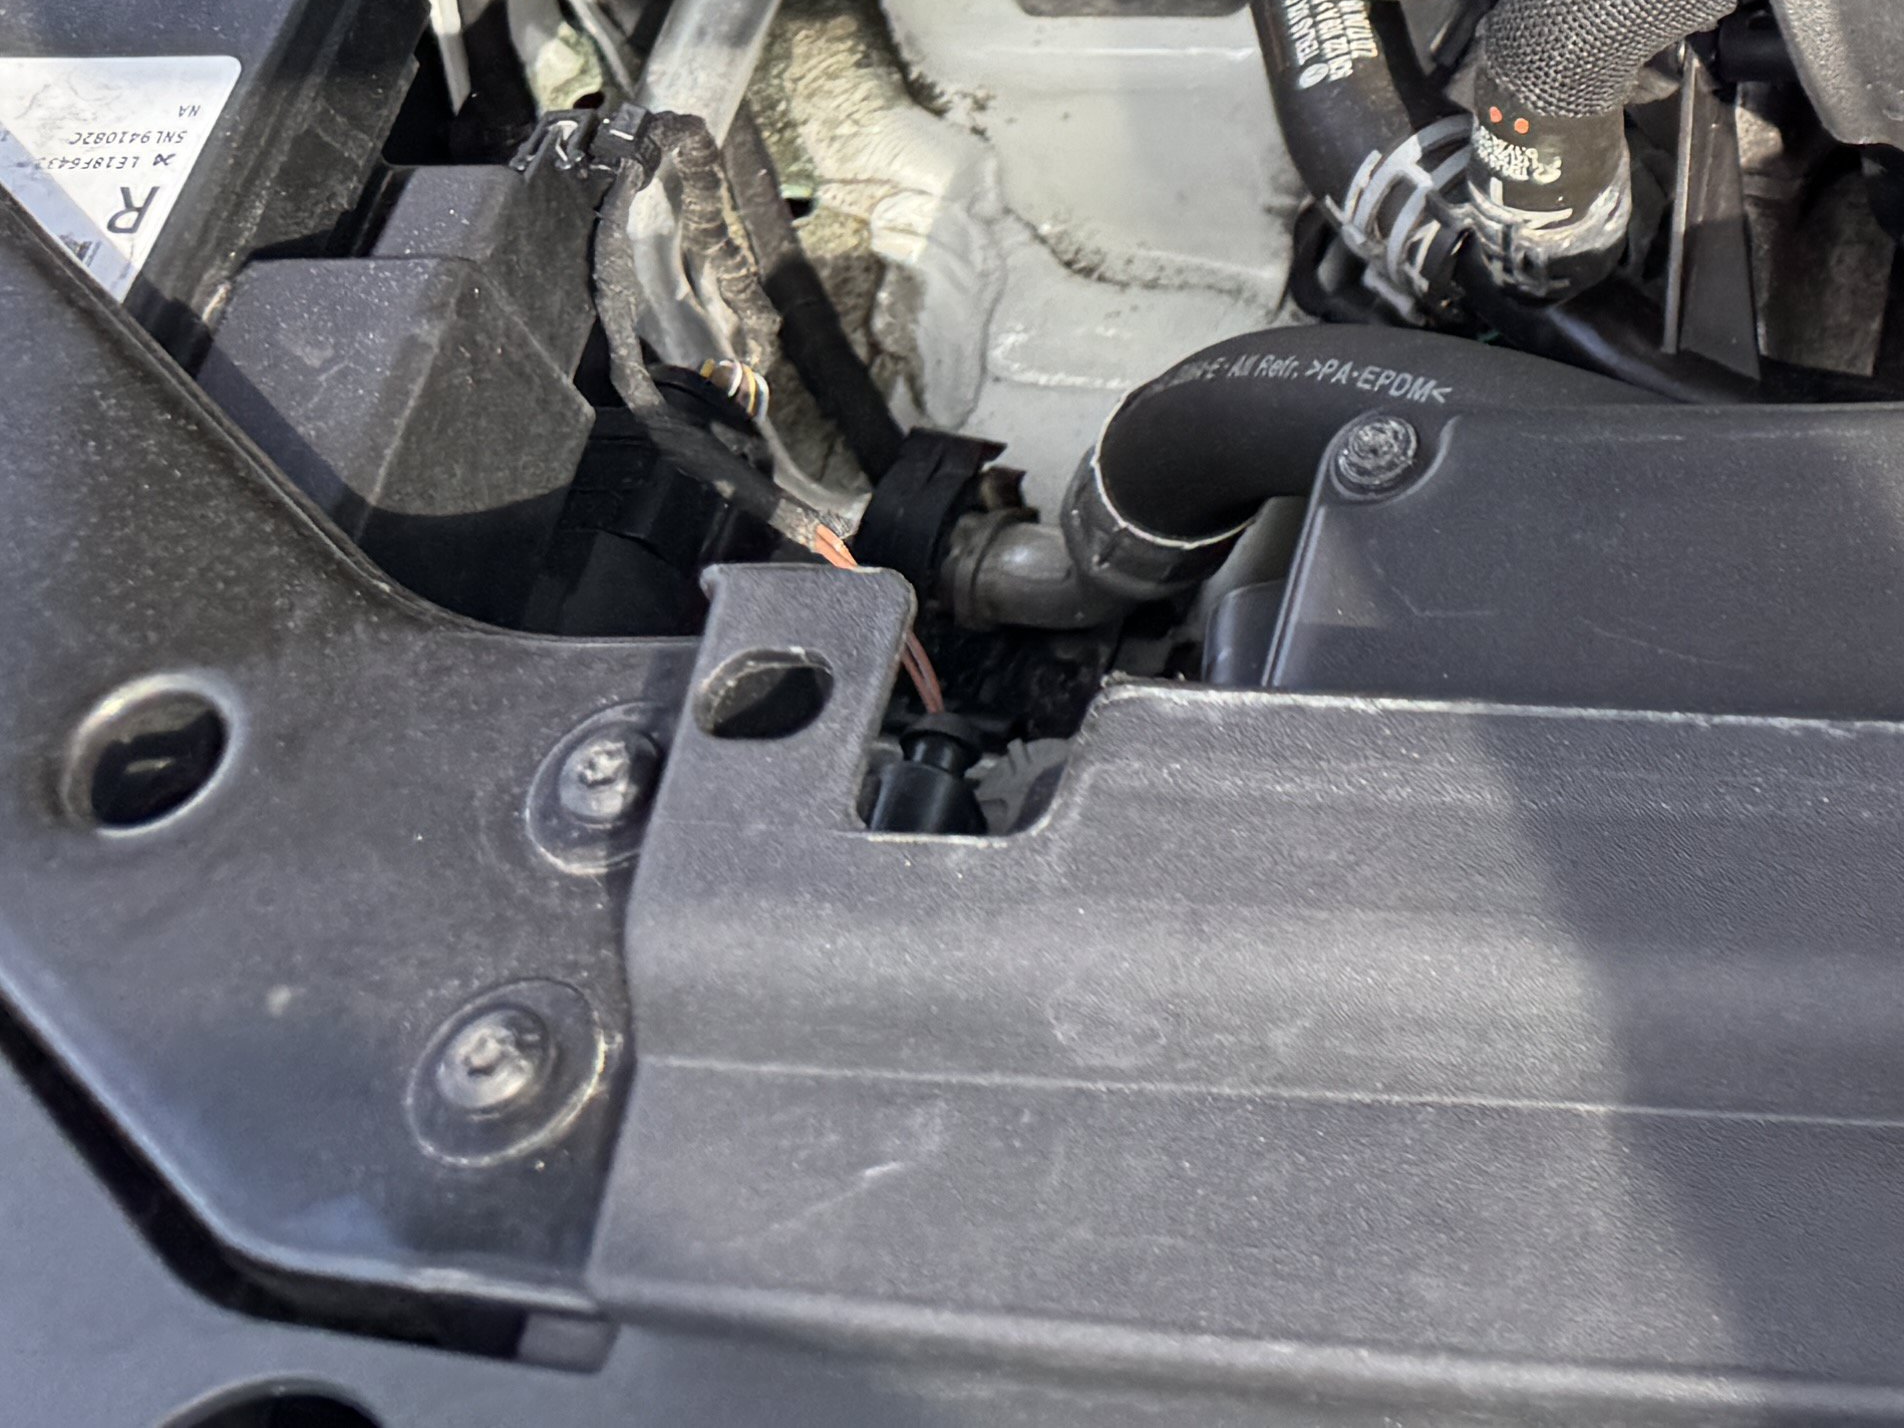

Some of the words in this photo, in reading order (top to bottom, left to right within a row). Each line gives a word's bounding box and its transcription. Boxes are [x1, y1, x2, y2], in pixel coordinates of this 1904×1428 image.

[178, 105, 202, 119] NA
[68, 129, 188, 146] 5NL941082C
[106, 185, 161, 235] R
